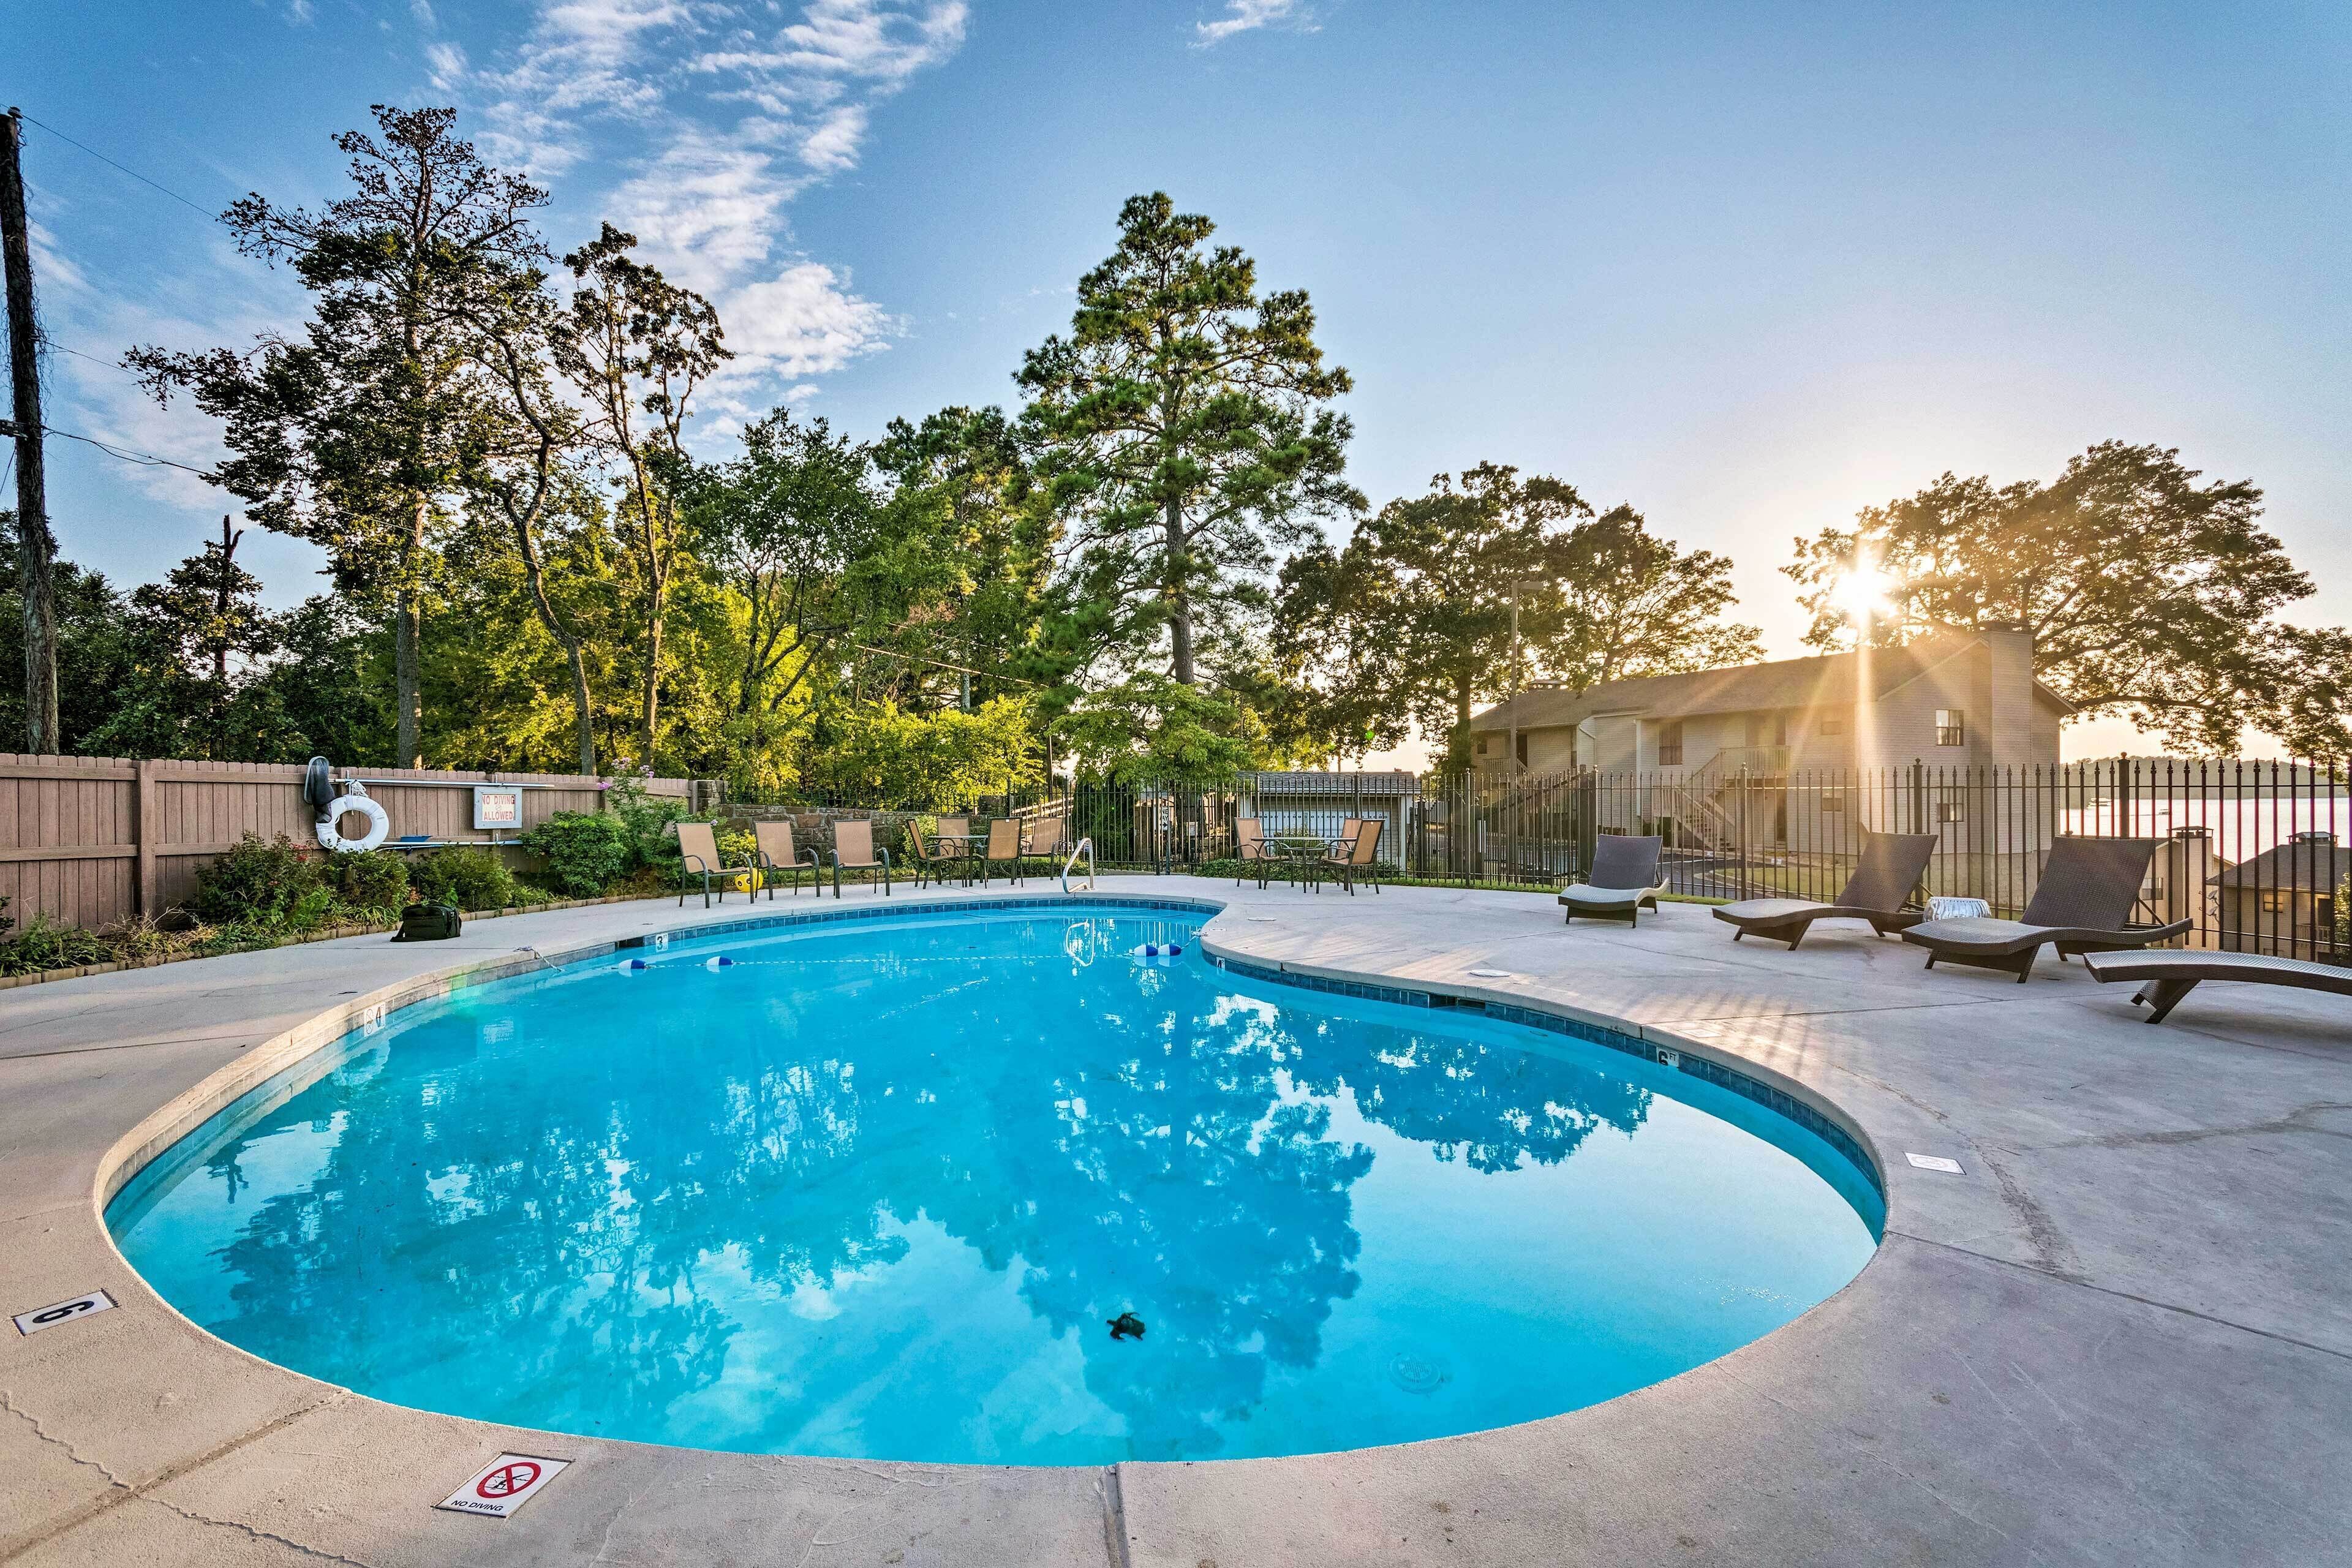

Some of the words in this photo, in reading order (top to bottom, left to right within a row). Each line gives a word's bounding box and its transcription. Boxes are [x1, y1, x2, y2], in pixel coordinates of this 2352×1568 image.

[494, 796, 515, 804] DIVING
[484, 811, 513, 821] ALLOWED
[1658, 1050, 1668, 1066] 6
[1669, 1052, 1676, 1061] FT
[469, 1502, 504, 1511] DIVING
